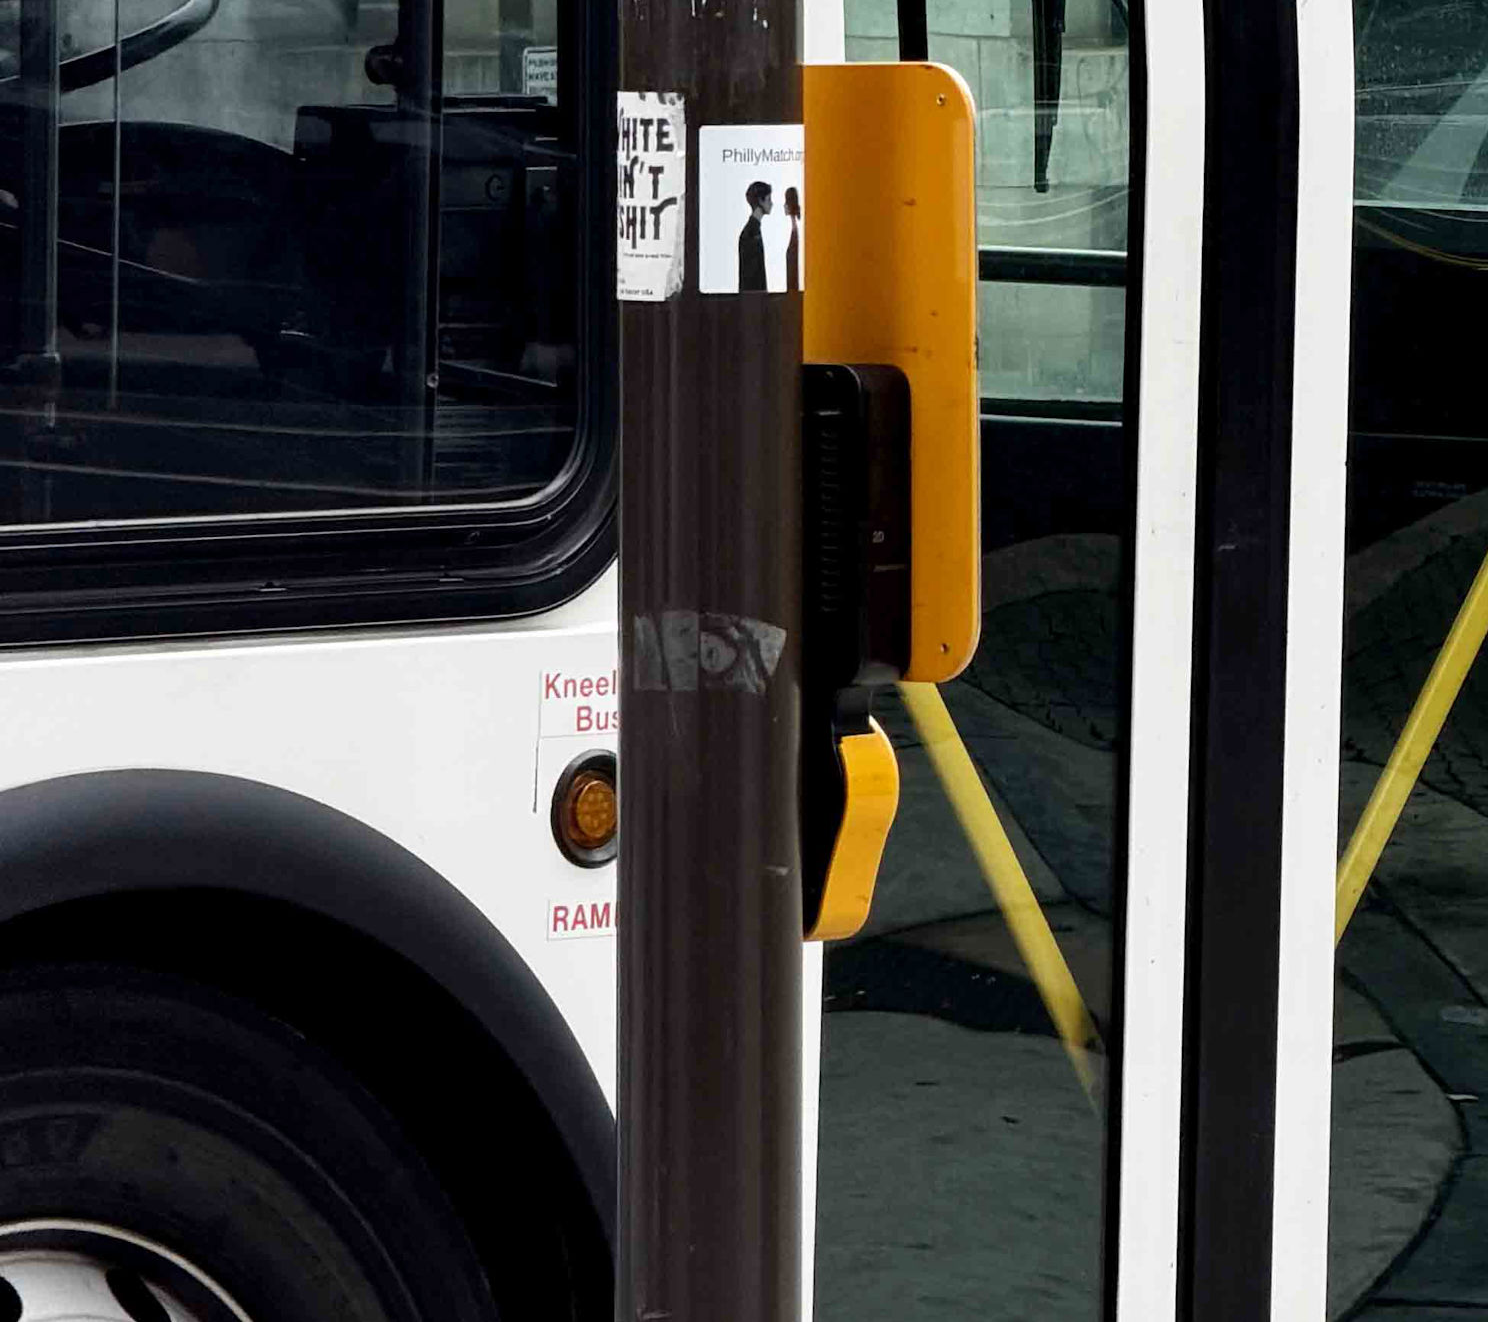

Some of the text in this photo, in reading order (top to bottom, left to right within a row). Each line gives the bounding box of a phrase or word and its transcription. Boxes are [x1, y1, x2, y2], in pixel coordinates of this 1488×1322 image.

[618, 107, 674, 161] HITE
[545, 670, 618, 700] Kneel
[576, 706, 620, 733] Bus
